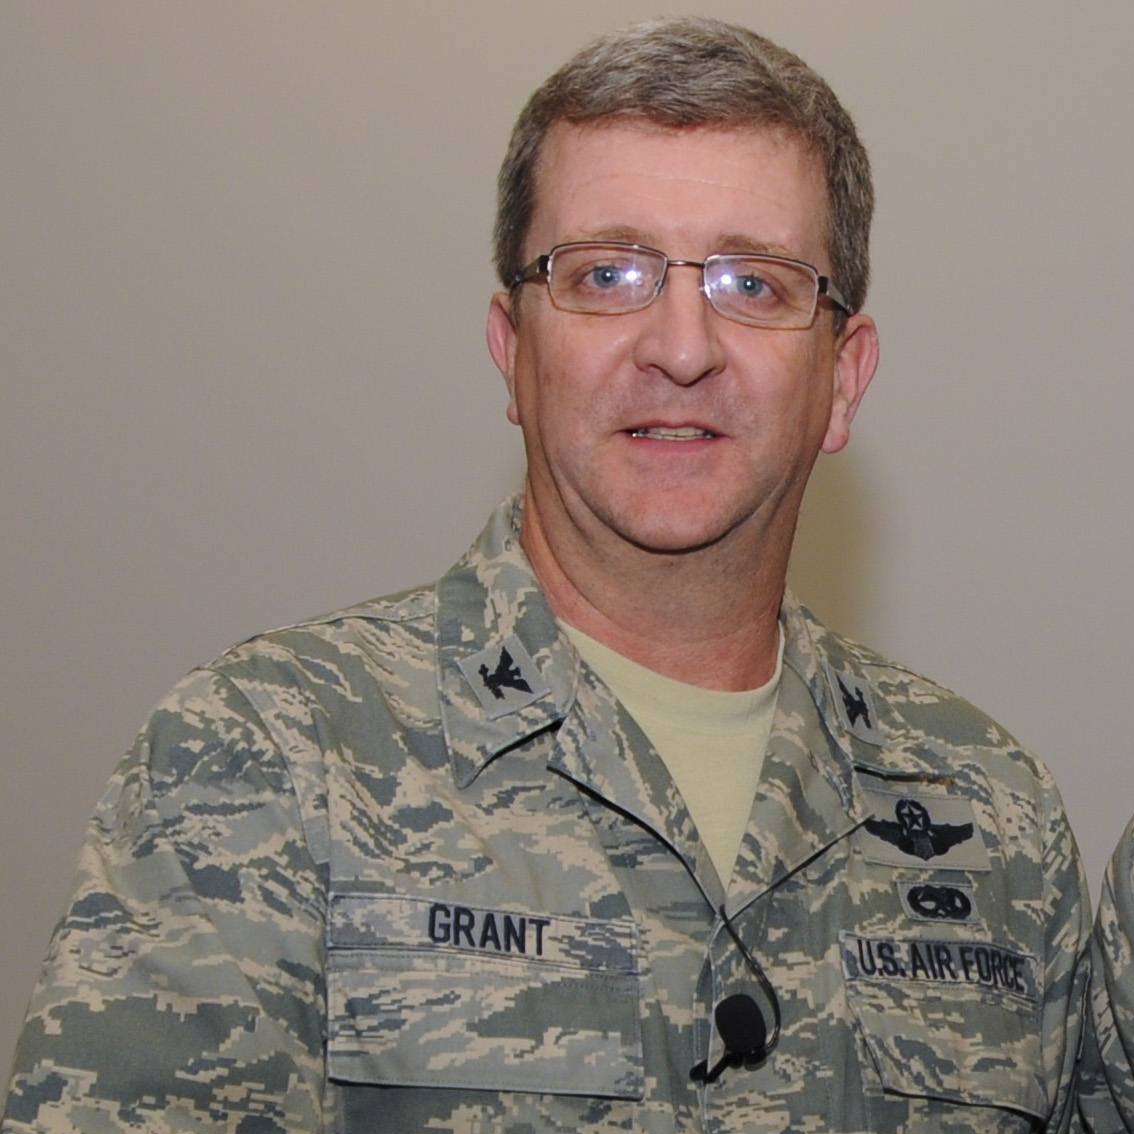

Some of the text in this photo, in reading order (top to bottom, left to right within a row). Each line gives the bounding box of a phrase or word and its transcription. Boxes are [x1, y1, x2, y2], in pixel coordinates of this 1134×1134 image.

[428, 903, 551, 956] GRANT
[857, 938, 1025, 991] U.S. AIR FORCE
